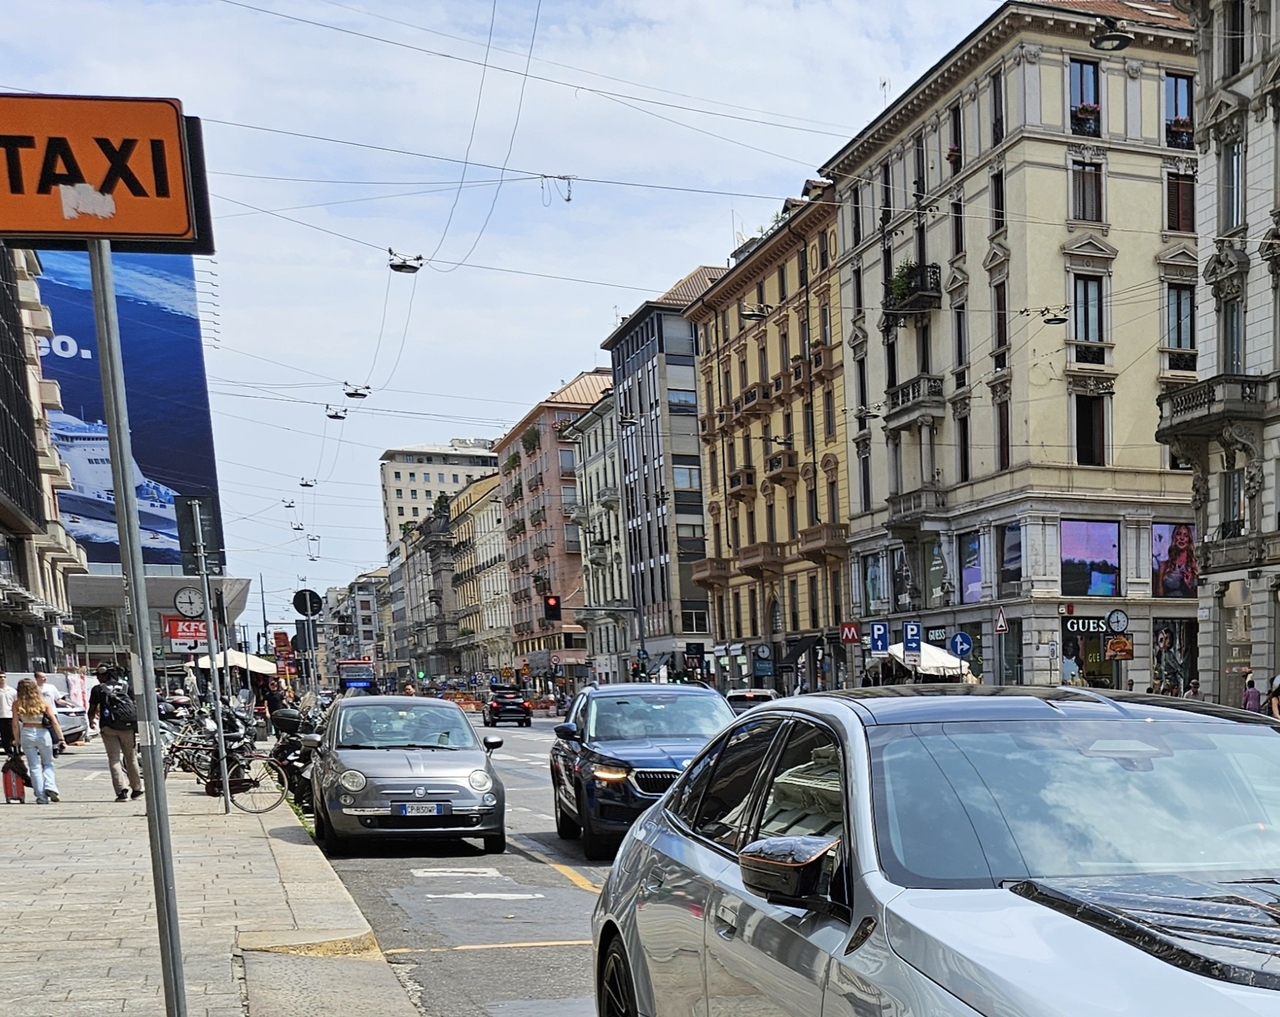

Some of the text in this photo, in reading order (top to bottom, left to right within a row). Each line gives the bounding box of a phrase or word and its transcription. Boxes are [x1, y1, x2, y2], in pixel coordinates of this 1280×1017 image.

[0, 135, 171, 199] TAXI
[873, 625, 885, 639] P
[907, 625, 919, 639] P
[928, 629, 946, 641] GUESS
